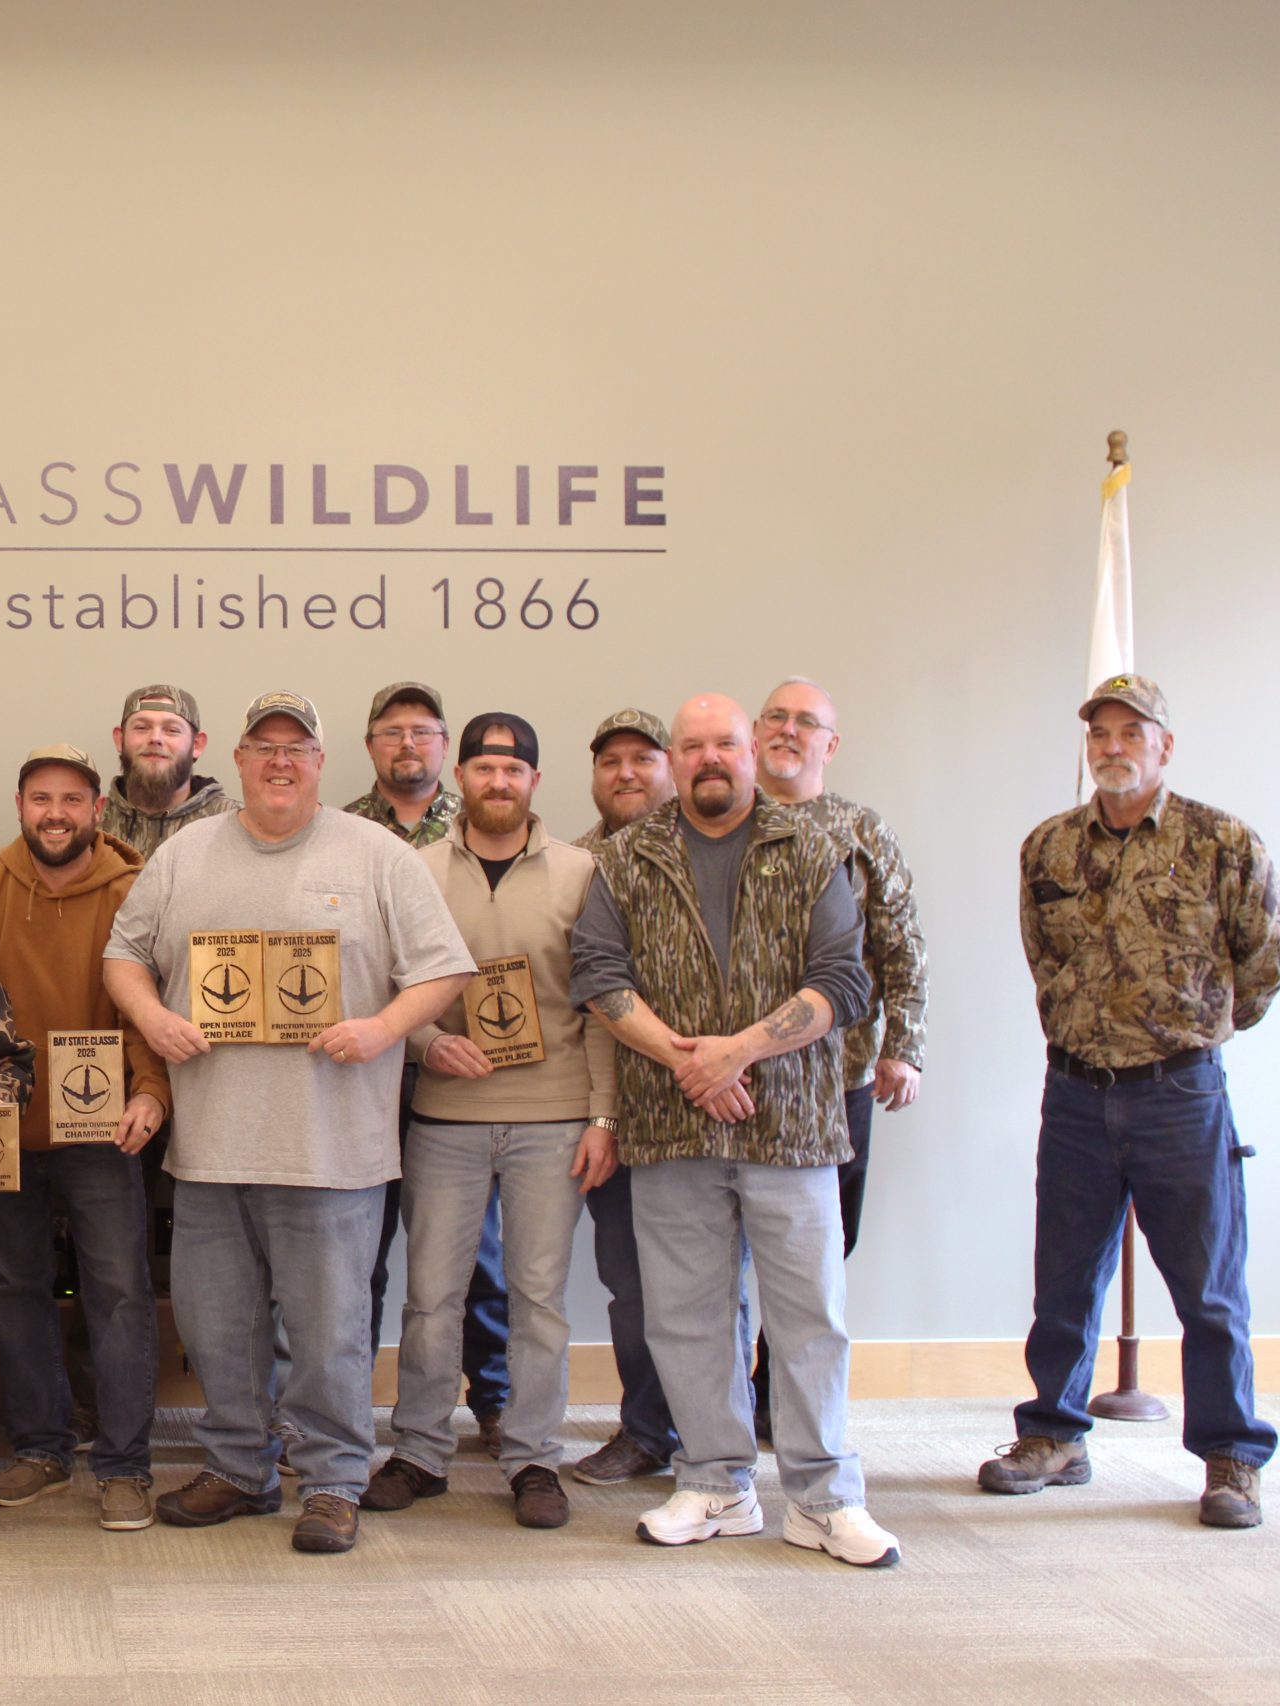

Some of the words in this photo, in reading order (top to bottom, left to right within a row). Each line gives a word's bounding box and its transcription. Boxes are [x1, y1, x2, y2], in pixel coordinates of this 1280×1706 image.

[431, 576, 602, 630] 1866
[192, 936, 206, 946] BAY
[208, 936, 228, 945] STATE
[230, 935, 259, 944] CLASSIC
[268, 937, 282, 946] BAY
[284, 936, 305, 946] STATE
[306, 935, 336, 945] CLASSIC
[216, 947, 236, 957] 2025
[292, 948, 312, 957] 2025
[498, 960, 526, 974] CLASSIC
[486, 975, 505, 987] 2025
[222, 1021, 256, 1029] DIVISION
[204, 1031, 222, 1039] 2ND
[225, 1031, 253, 1039] PLACE
[53, 1037, 67, 1046] BAY
[68, 1036, 89, 1046] STATE
[90, 1036, 119, 1046] CLASSIC
[77, 1048, 96, 1057] 2025
[483, 1047, 508, 1057] CATOR
[508, 1041, 538, 1052] DIVISION
[506, 1051, 533, 1062] PLACE
